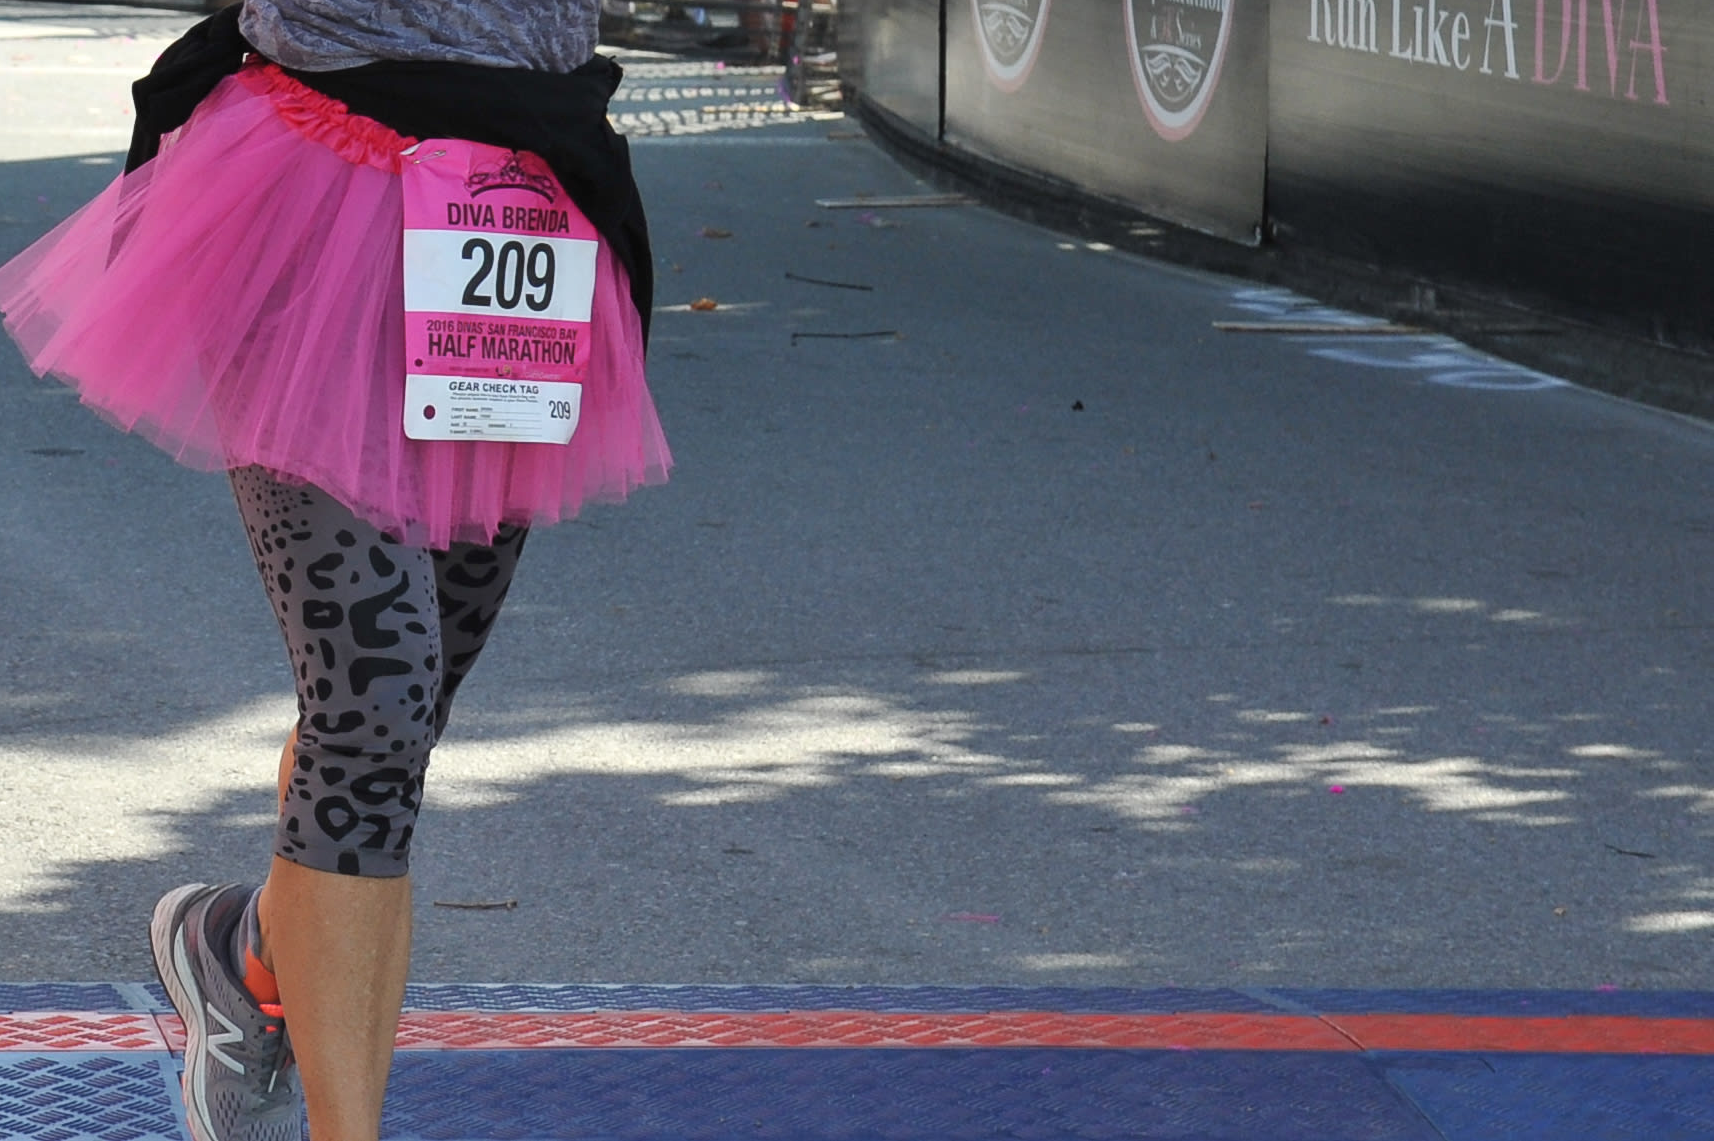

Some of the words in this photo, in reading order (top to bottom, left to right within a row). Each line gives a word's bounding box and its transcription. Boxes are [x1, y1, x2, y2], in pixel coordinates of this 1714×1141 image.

[447, 203, 496, 228] DIVA
[502, 206, 569, 233] BRENDA
[461, 238, 556, 312] 209
[427, 319, 455, 332] 2016
[488, 323, 505, 335] SAN
[507, 325, 557, 340] FRANCISCO
[559, 328, 578, 340] BAY
[428, 333, 477, 359] HALF
[481, 336, 576, 365] MARATHON
[449, 381, 480, 392] GEAR
[482, 383, 517, 394] CHECK
[519, 385, 539, 394] TAG
[548, 400, 571, 420] 209
